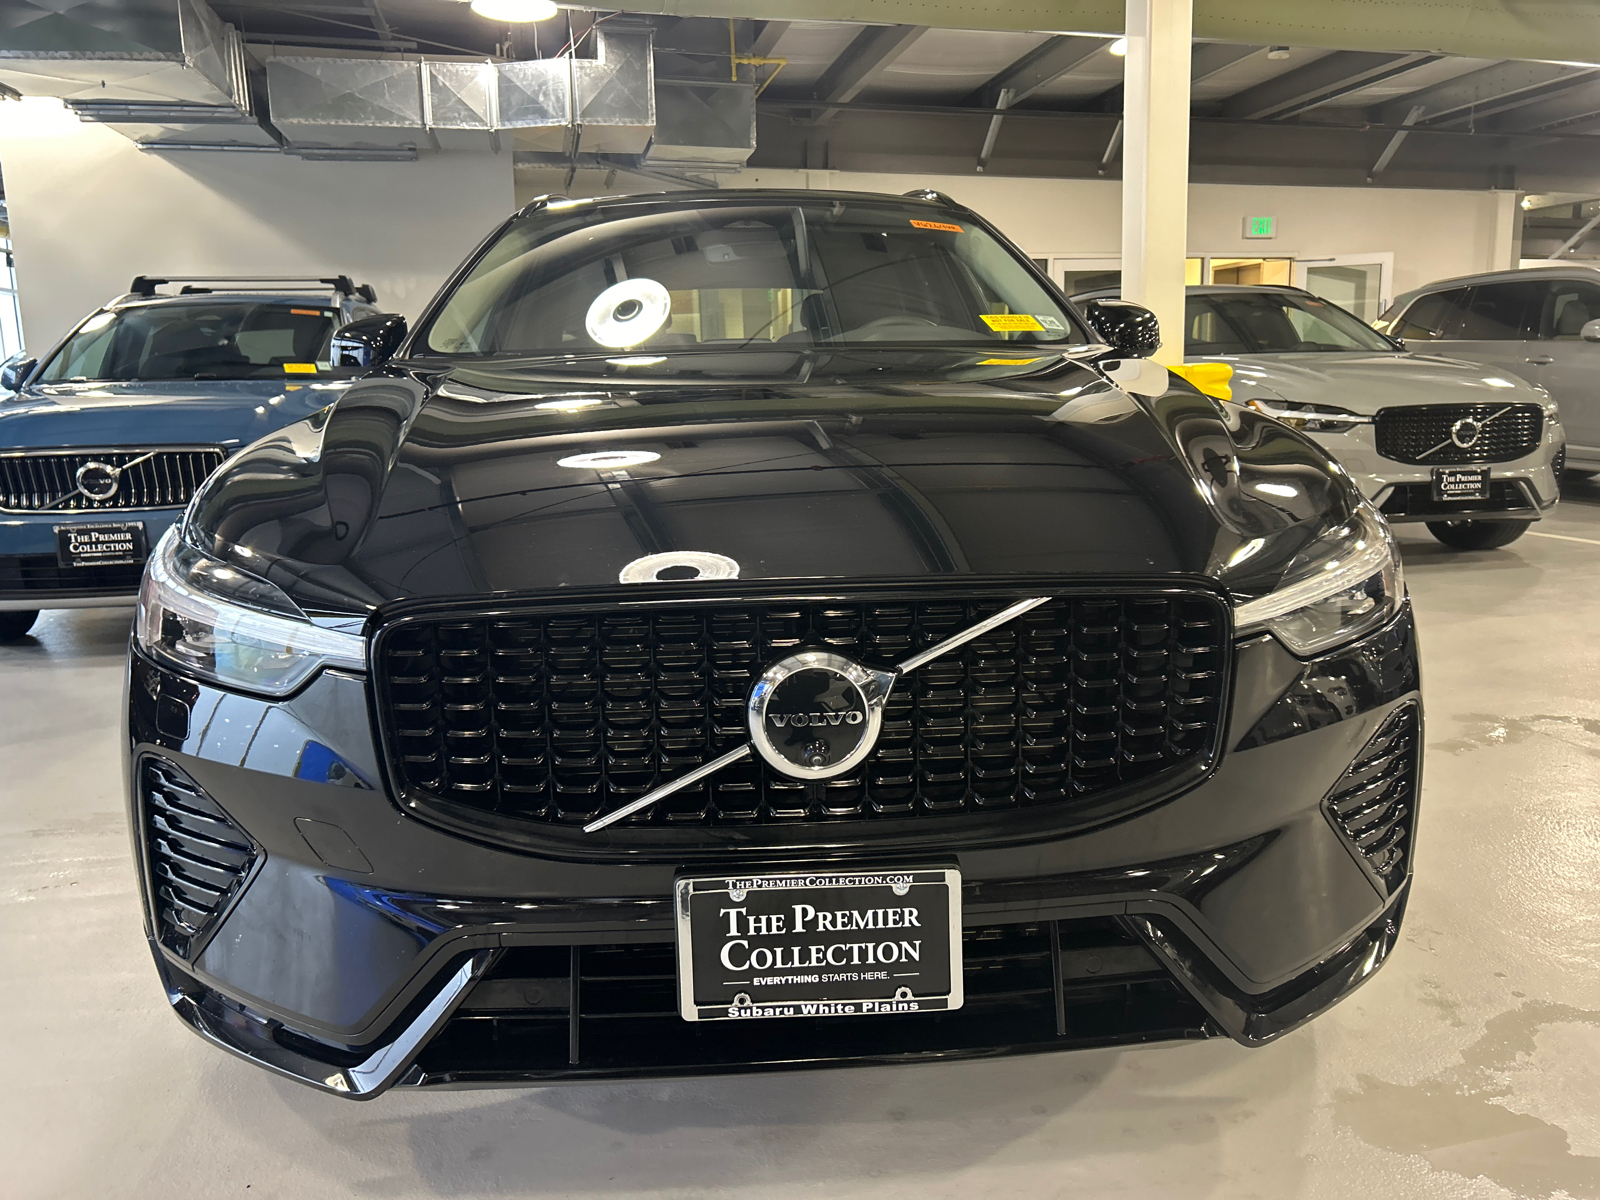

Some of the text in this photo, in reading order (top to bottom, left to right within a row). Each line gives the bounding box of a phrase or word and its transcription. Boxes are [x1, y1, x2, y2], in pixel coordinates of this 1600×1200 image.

[1252, 217, 1273, 235] EXIT
[1442, 473, 1482, 482] THE PREMIER
[1441, 482, 1482, 490] COLLECTION
[68, 531, 132, 543] THE PREMIER
[69, 542, 133, 553] COLLECTION
[768, 710, 864, 728] VOLVO
[720, 904, 921, 937] THE PREMIER
[720, 940, 921, 971] COLLECTION
[753, 971, 890, 986] EVERYTHING STARTS HERE.
[728, 1001, 919, 1018] Subaru White Plains
